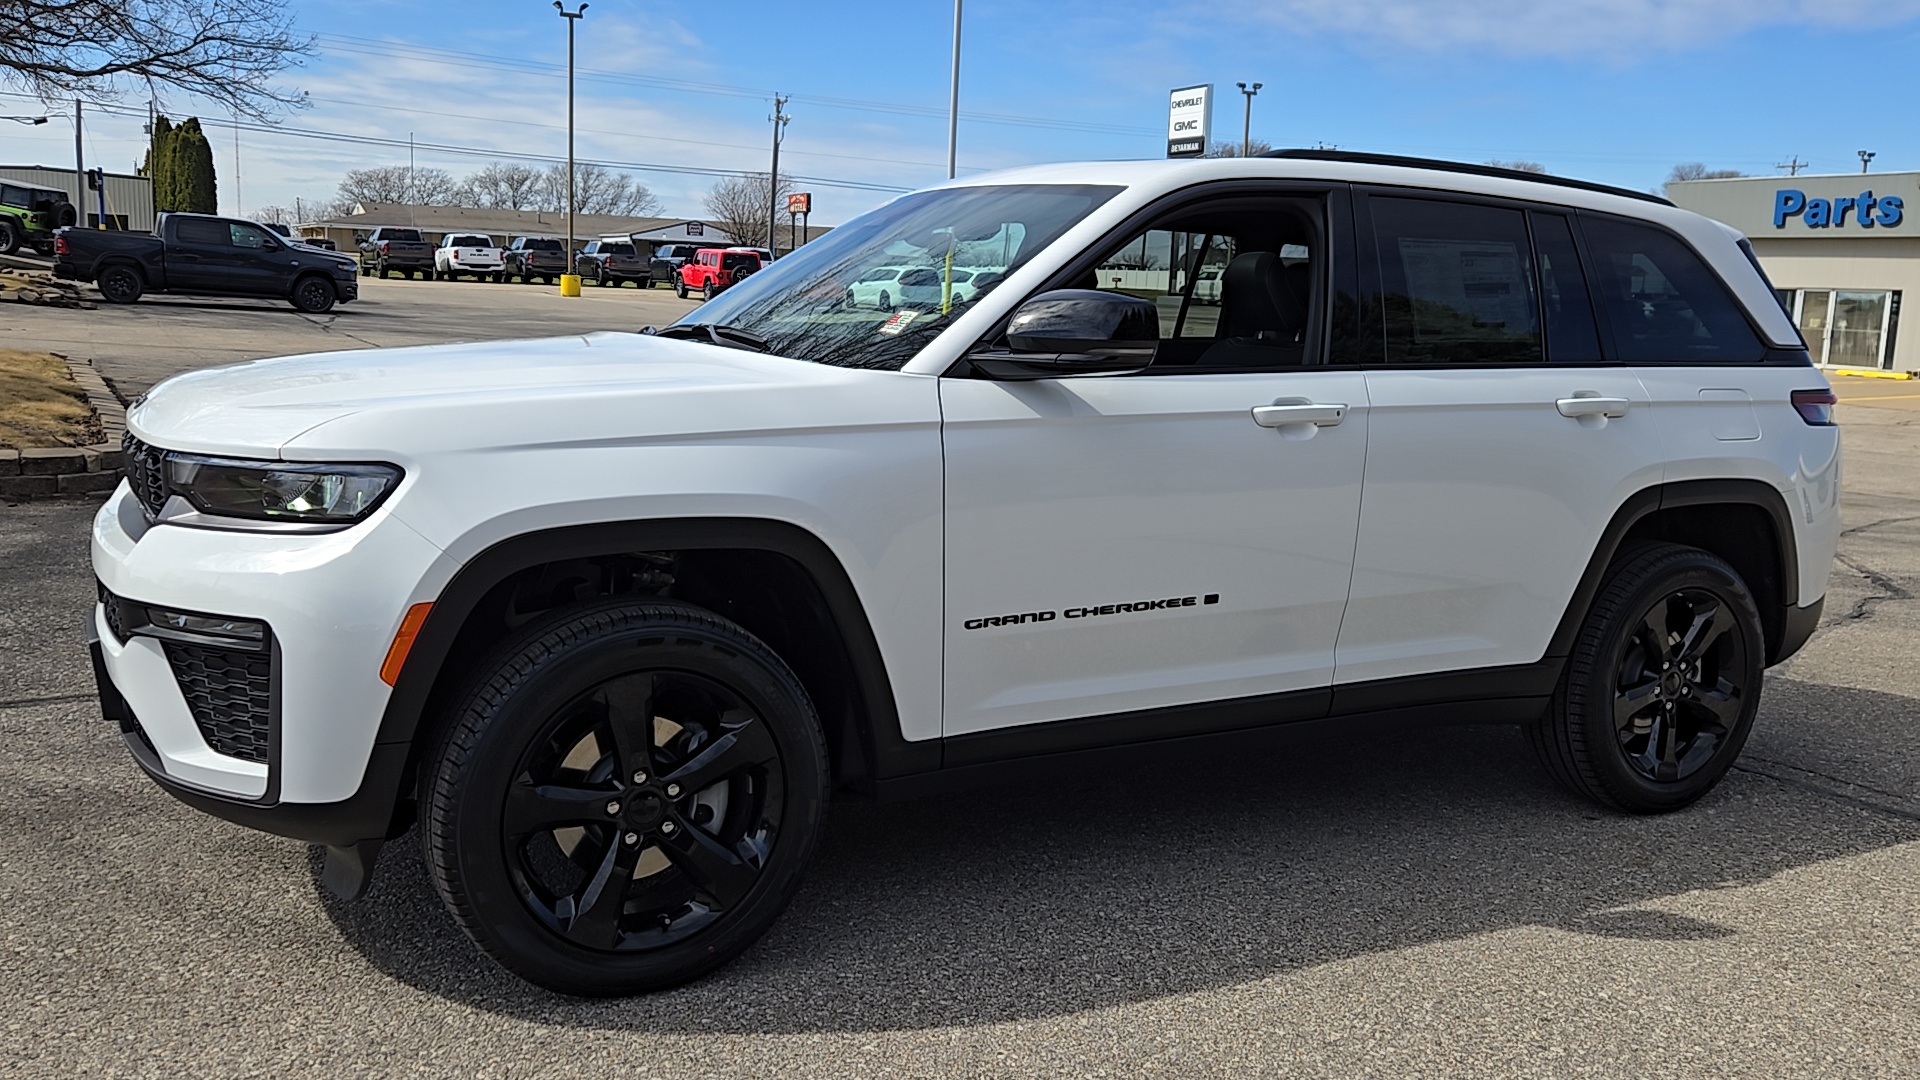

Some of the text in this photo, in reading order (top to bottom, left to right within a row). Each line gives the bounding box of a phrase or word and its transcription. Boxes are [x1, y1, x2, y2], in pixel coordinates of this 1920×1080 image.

[1172, 97, 1202, 109] CHEVROLET
[1174, 120, 1198, 131] GMC
[1773, 188, 1904, 229] Parts
[964, 596, 1197, 630] GRAND CHEROKEE
